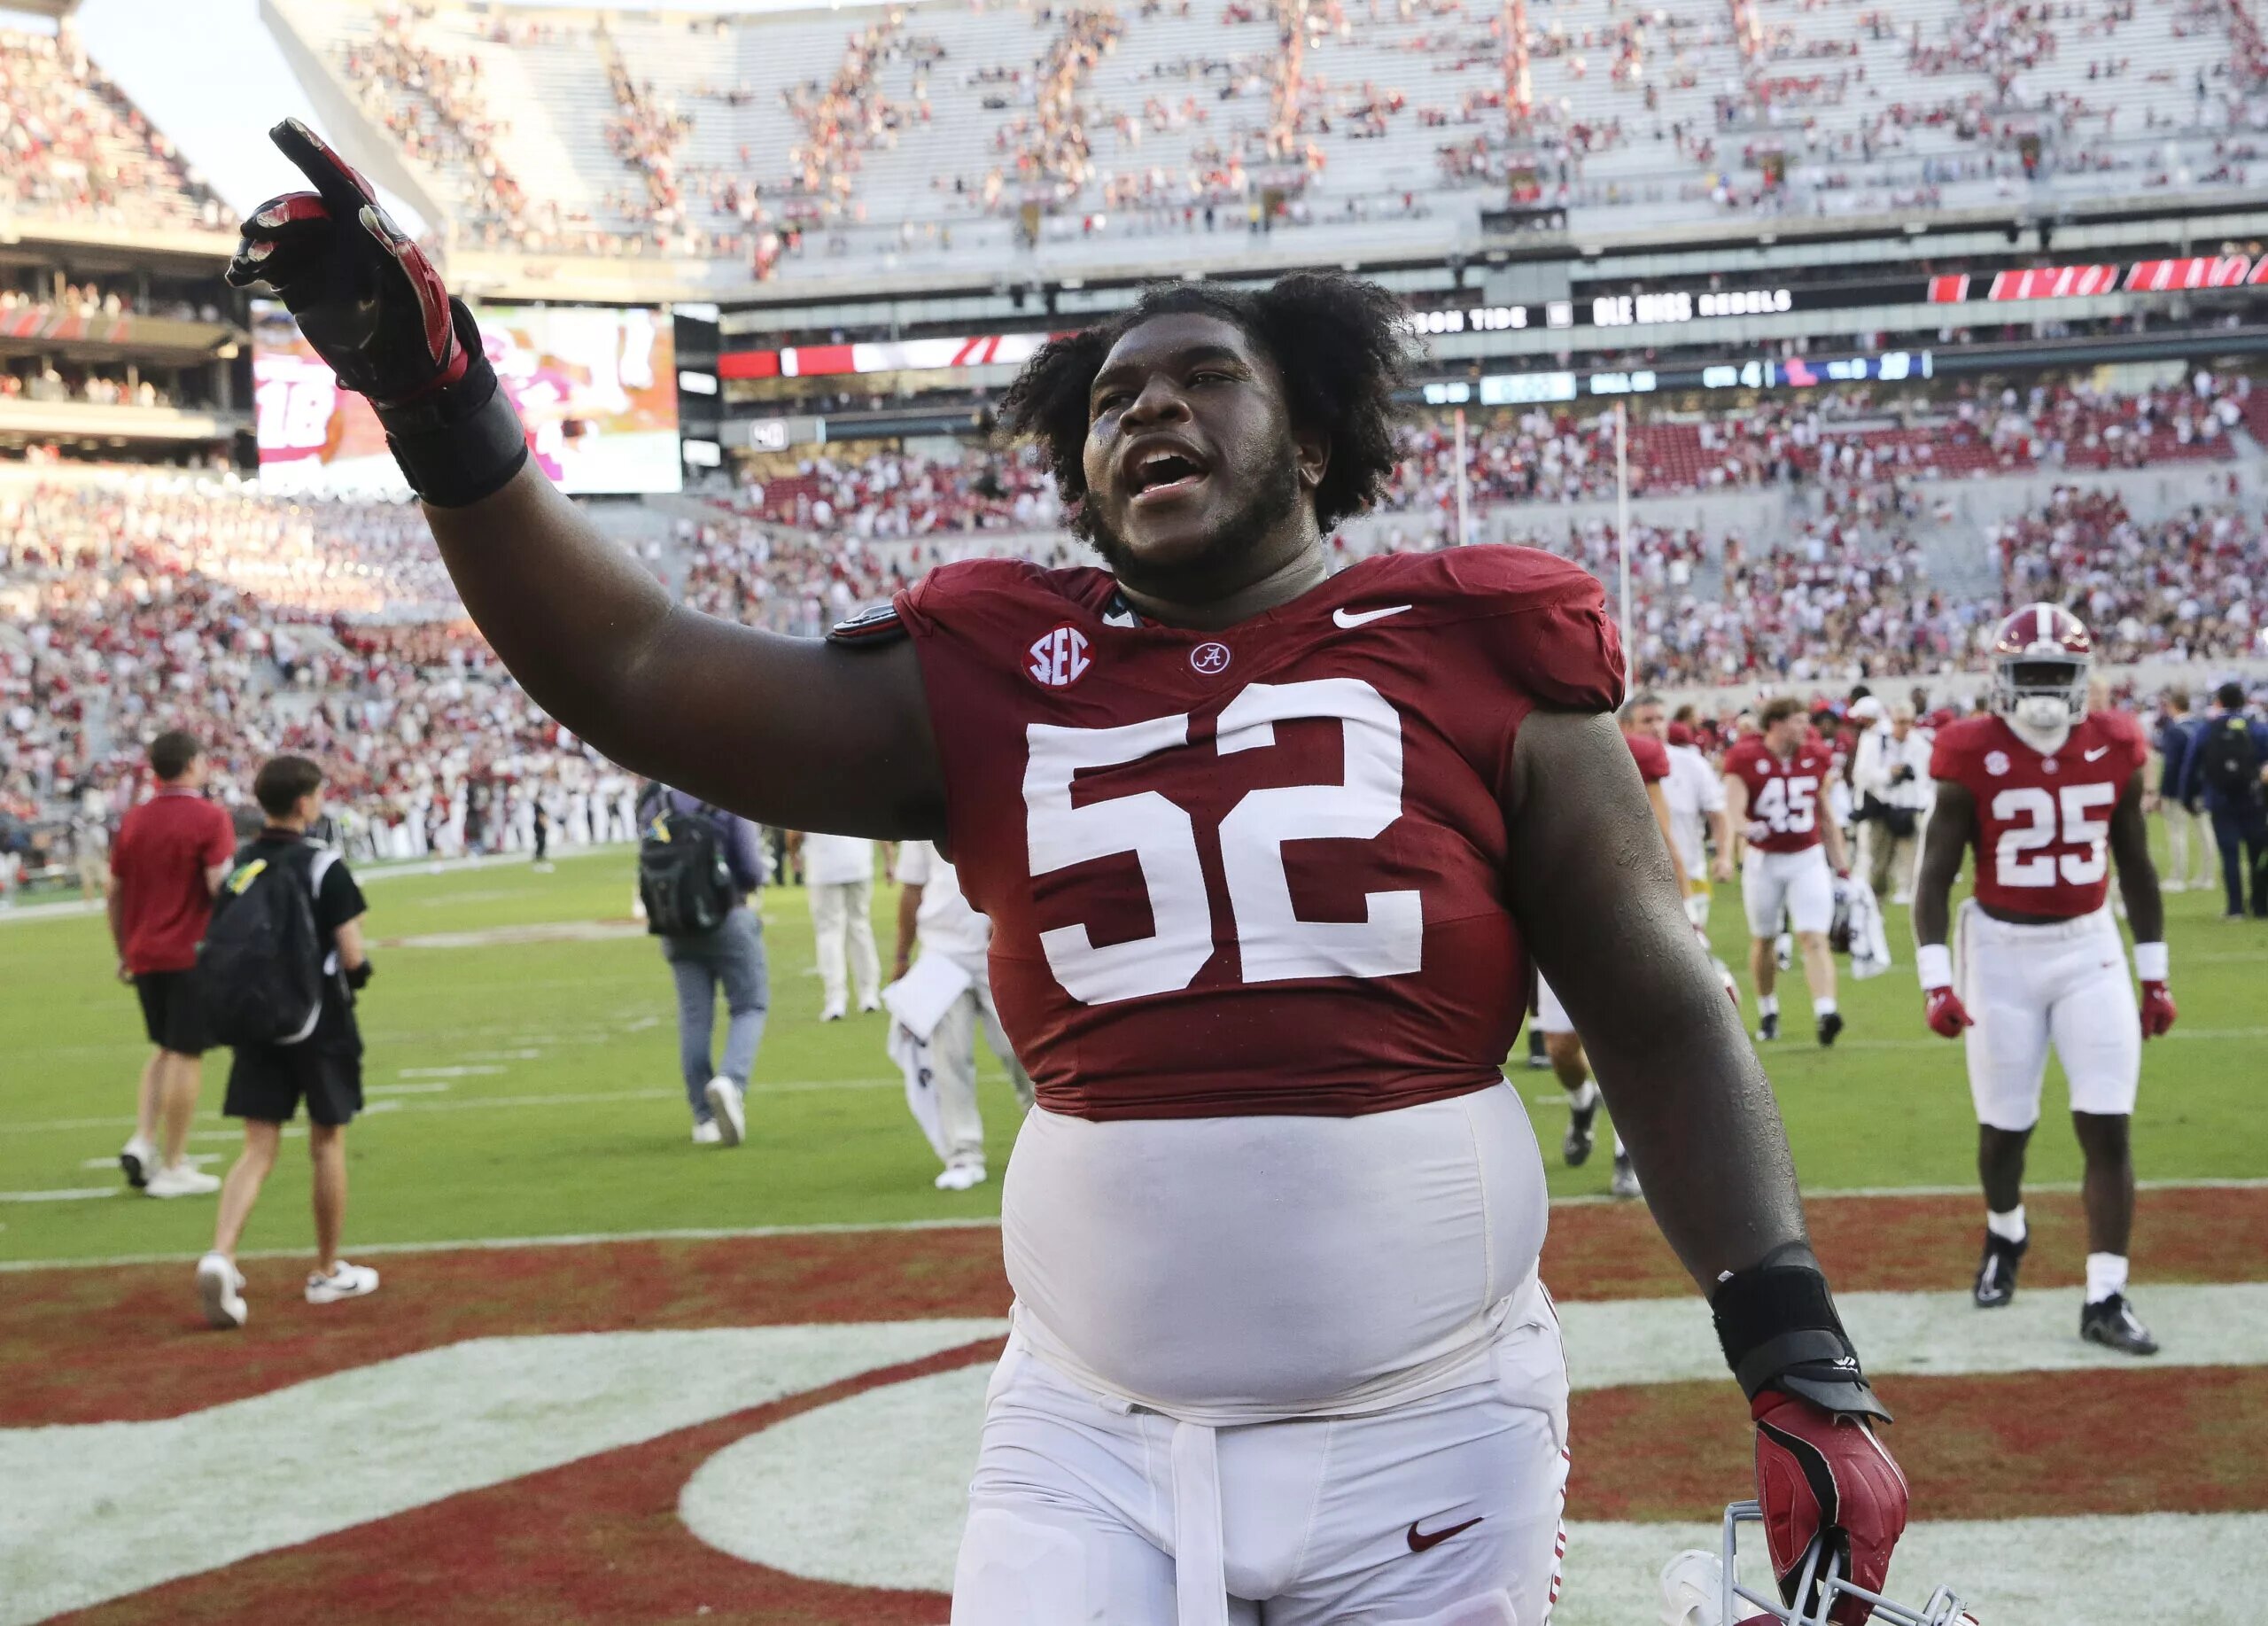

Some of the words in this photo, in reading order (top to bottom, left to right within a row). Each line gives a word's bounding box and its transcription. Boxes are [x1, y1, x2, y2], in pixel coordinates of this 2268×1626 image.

[1469, 306, 1527, 331] TIDE
[1593, 296, 1633, 327] OLE
[1698, 289, 1791, 316] REBELS
[1029, 626, 1091, 686] SEC
[1753, 775, 1819, 833] 45
[1991, 780, 2116, 887] 25
[1022, 677, 1423, 1006] 52
